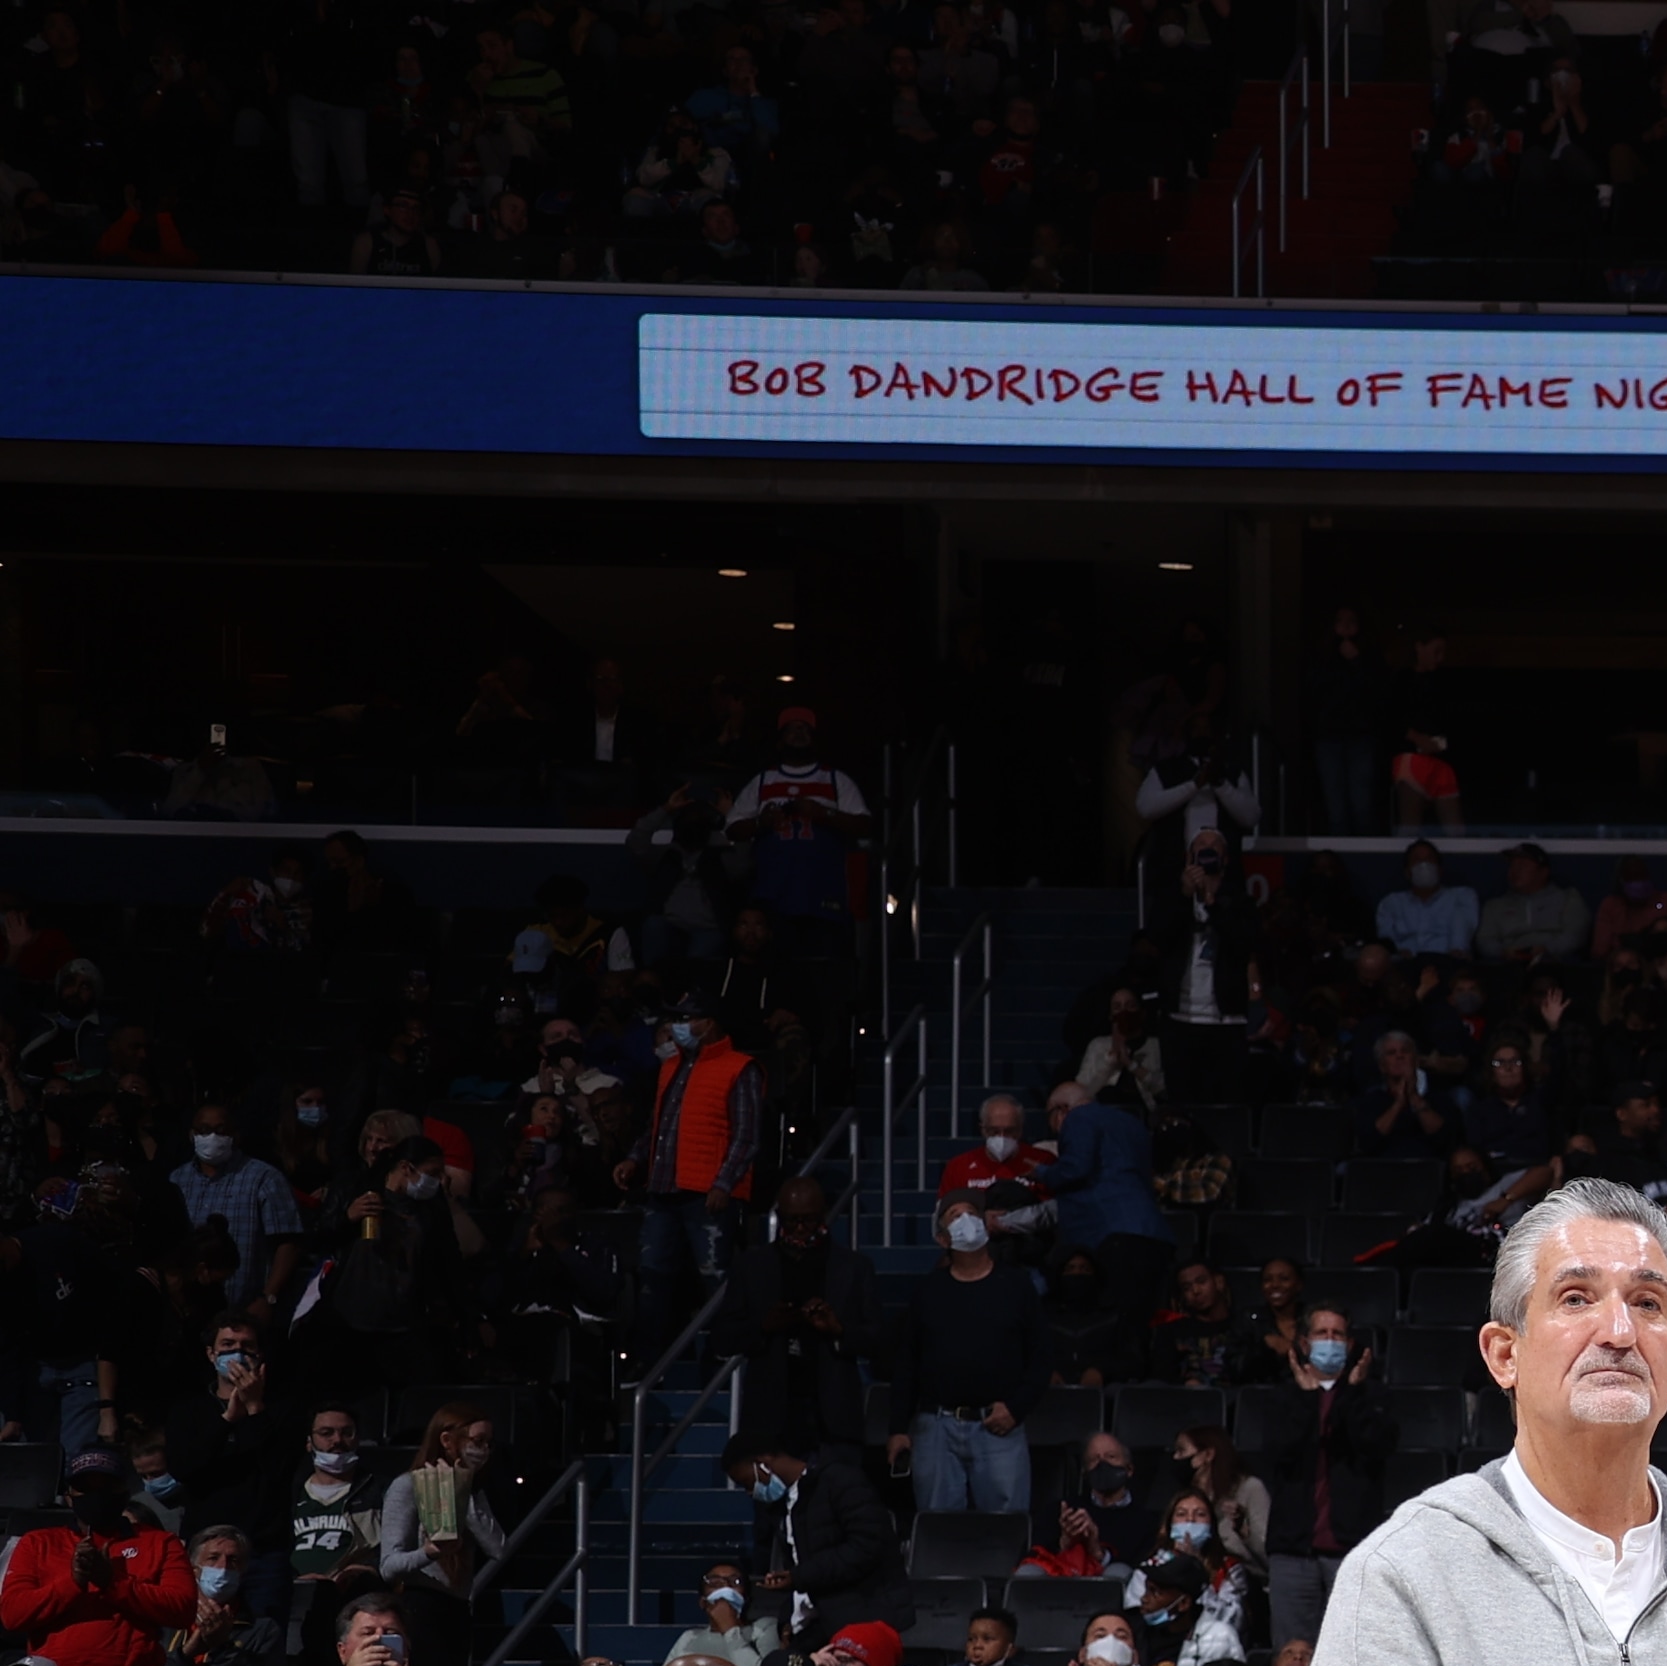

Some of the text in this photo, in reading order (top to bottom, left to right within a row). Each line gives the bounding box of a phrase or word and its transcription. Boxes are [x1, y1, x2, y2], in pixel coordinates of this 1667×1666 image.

[727, 360, 826, 397] BOB
[849, 363, 1163, 404] DANDRIDGE
[1185, 370, 1314, 406] HALL
[1336, 371, 1403, 407] OF
[1426, 374, 1570, 411] FAME
